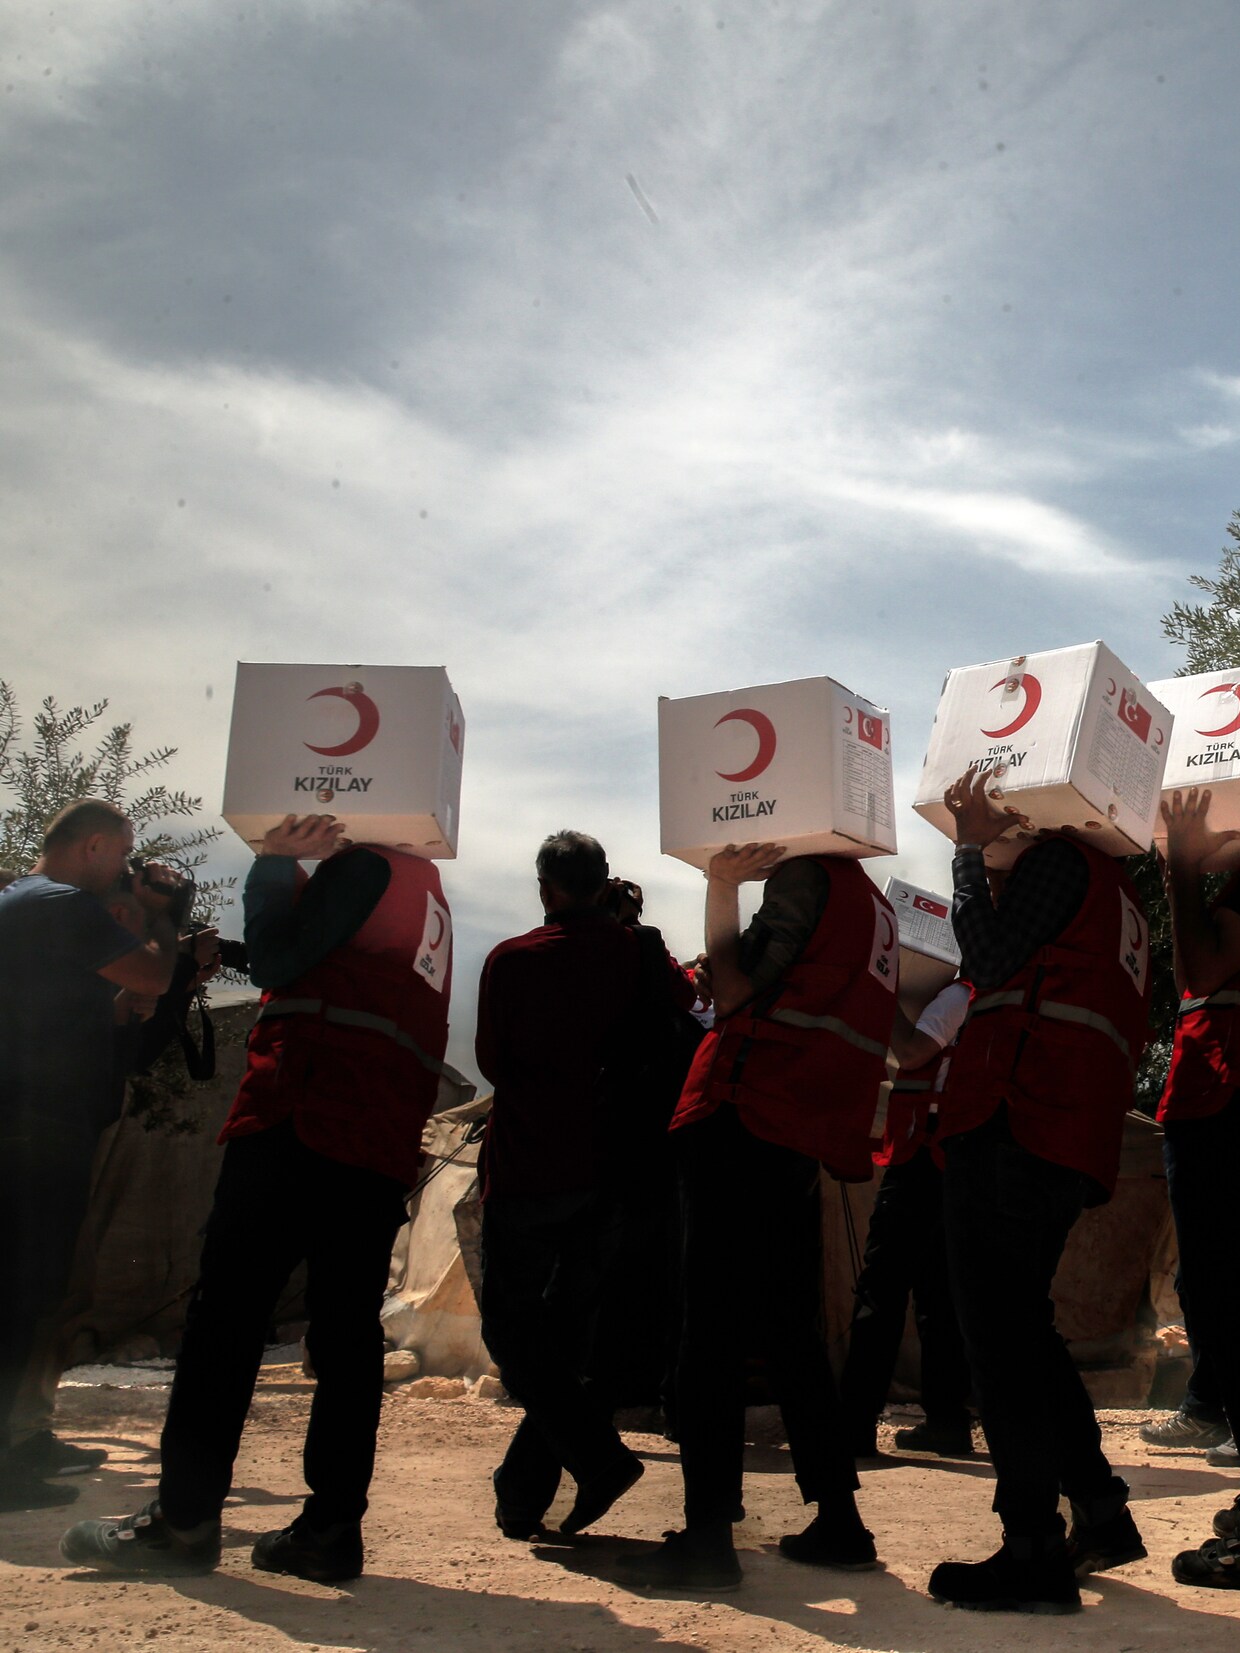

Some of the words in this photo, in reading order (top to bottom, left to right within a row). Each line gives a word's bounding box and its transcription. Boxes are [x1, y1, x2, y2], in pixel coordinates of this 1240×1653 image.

[987, 744, 1013, 756] TÜRK
[1206, 742, 1235, 751] TÜRK
[318, 765, 353, 775] TÜRK
[294, 777, 373, 792] KIZILAY
[730, 791, 759, 802] TÜRK
[712, 799, 777, 822] KIZILAY
